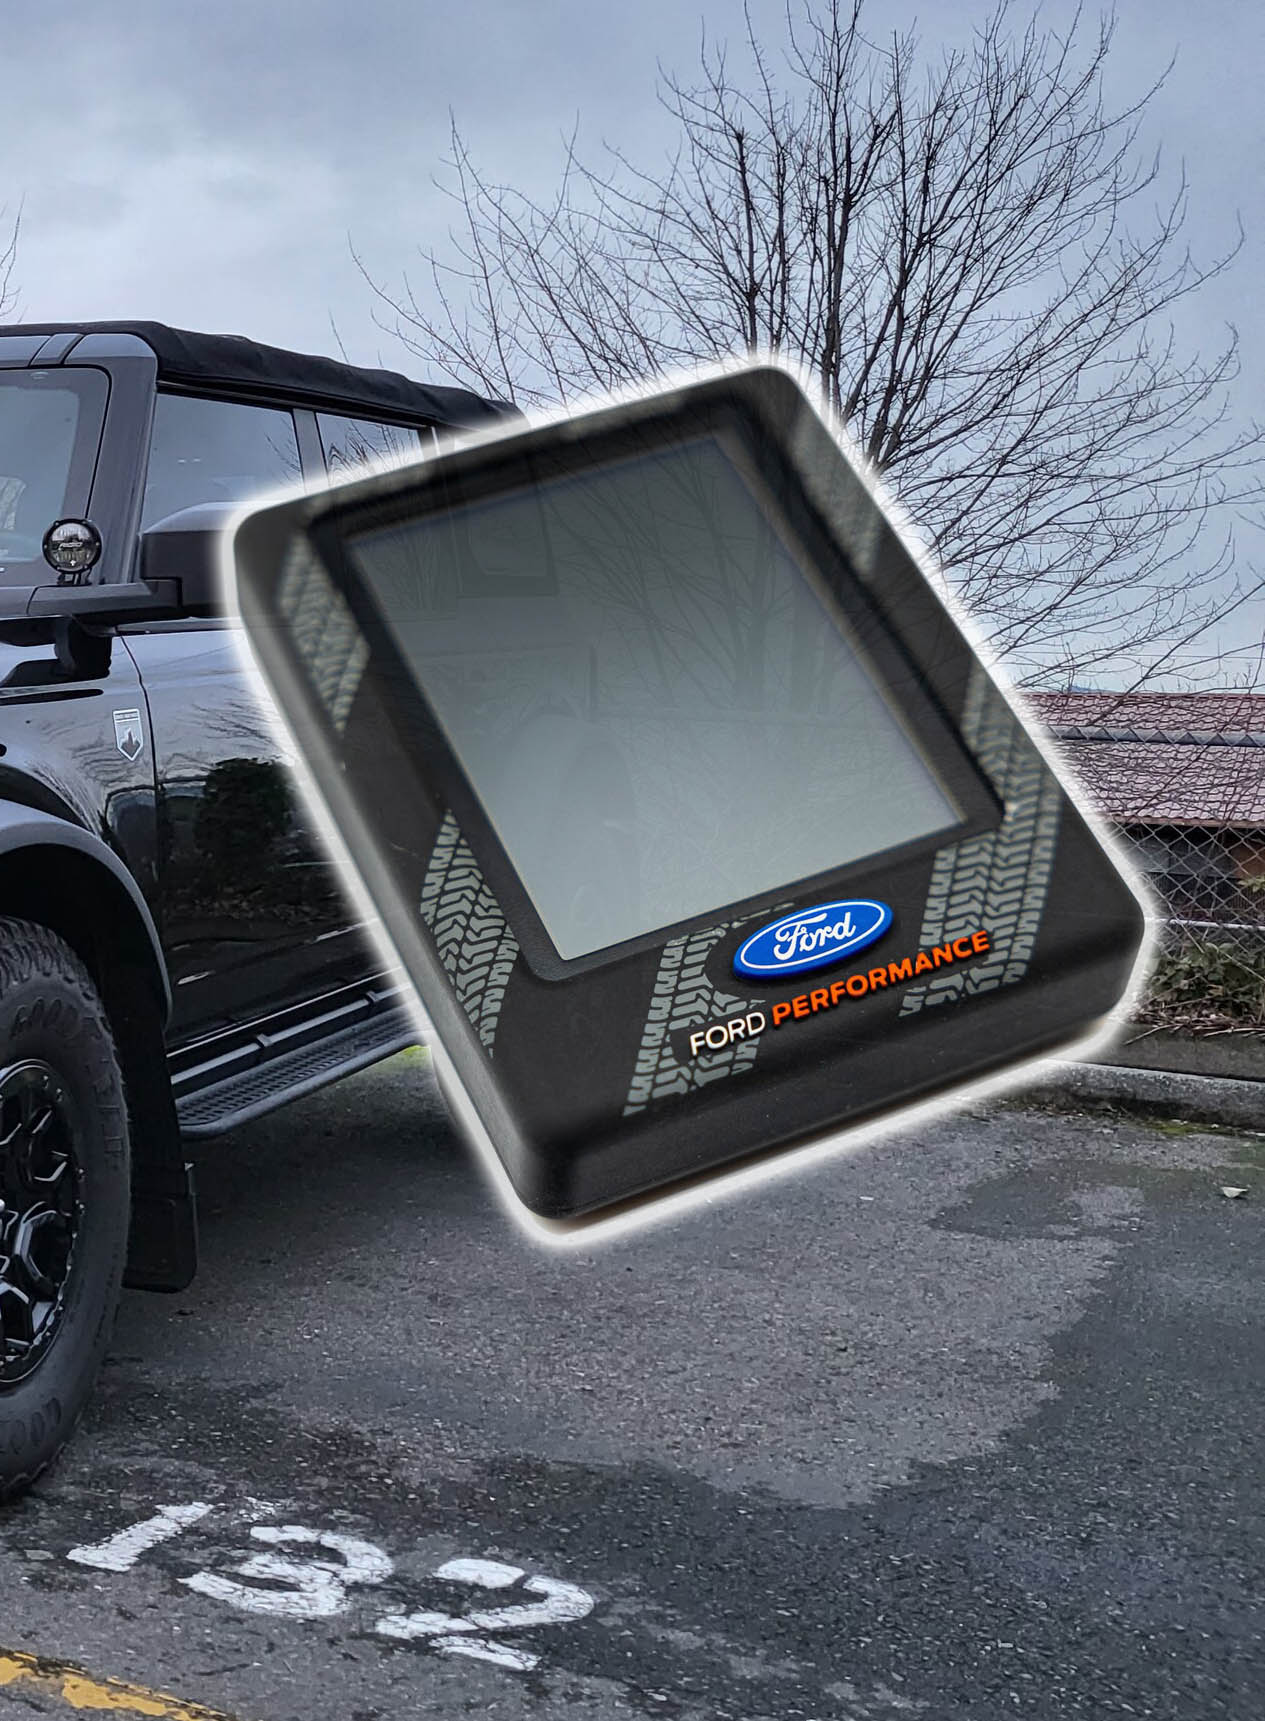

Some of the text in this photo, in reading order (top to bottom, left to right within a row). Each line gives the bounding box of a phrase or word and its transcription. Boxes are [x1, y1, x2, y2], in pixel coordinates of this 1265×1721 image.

[689, 931, 990, 1057] FORD PERFORMANCE
[773, 911, 857, 961] Ford
[67, 1502, 594, 1671] 132
